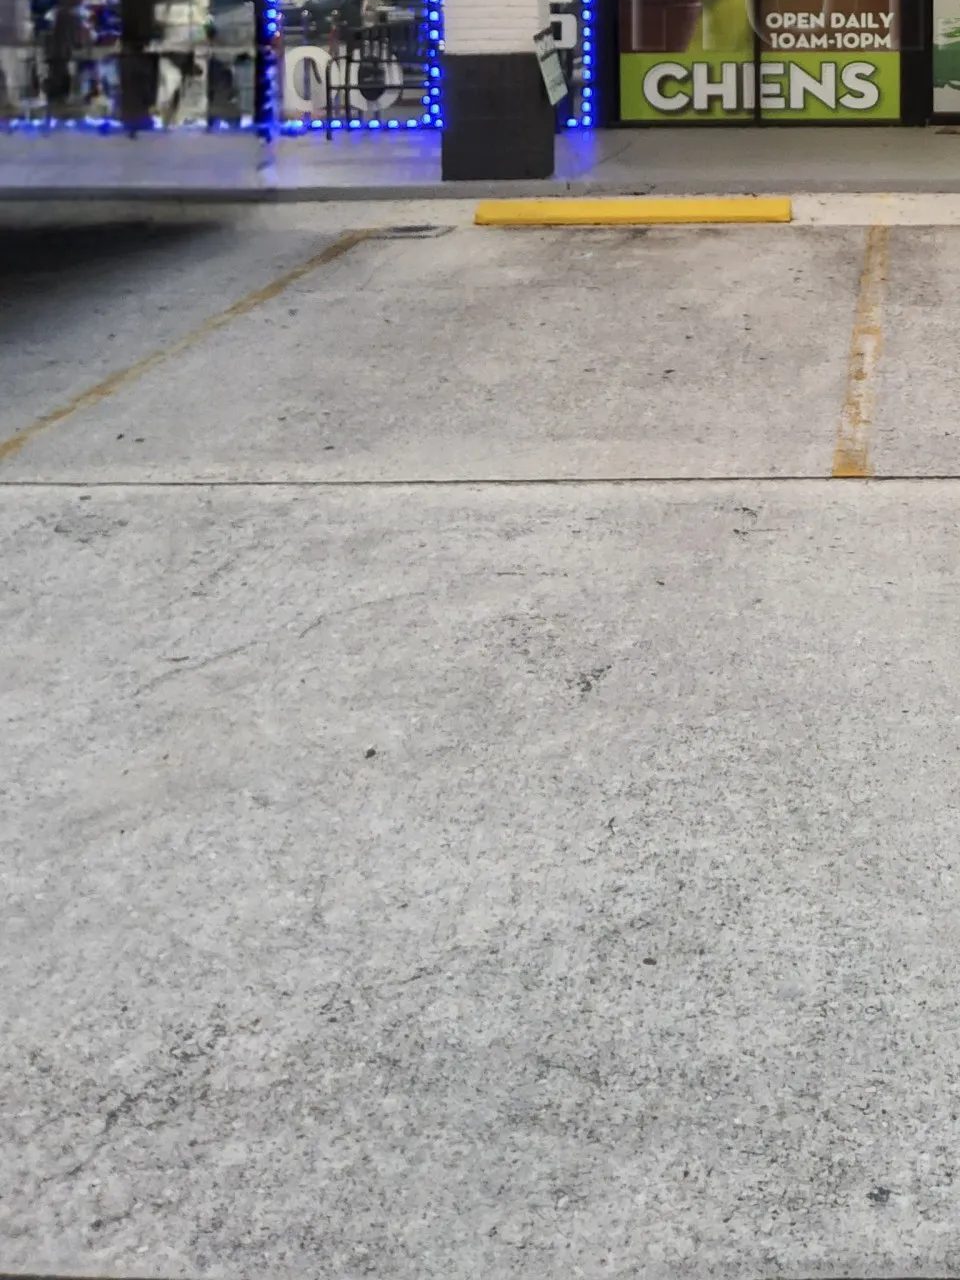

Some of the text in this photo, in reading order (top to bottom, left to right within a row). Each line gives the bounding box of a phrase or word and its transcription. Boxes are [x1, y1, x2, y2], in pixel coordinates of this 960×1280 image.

[765, 11, 894, 29] OPEN DAILY
[770, 32, 892, 49] 10AM-10PM
[643, 62, 879, 111] CHENS
